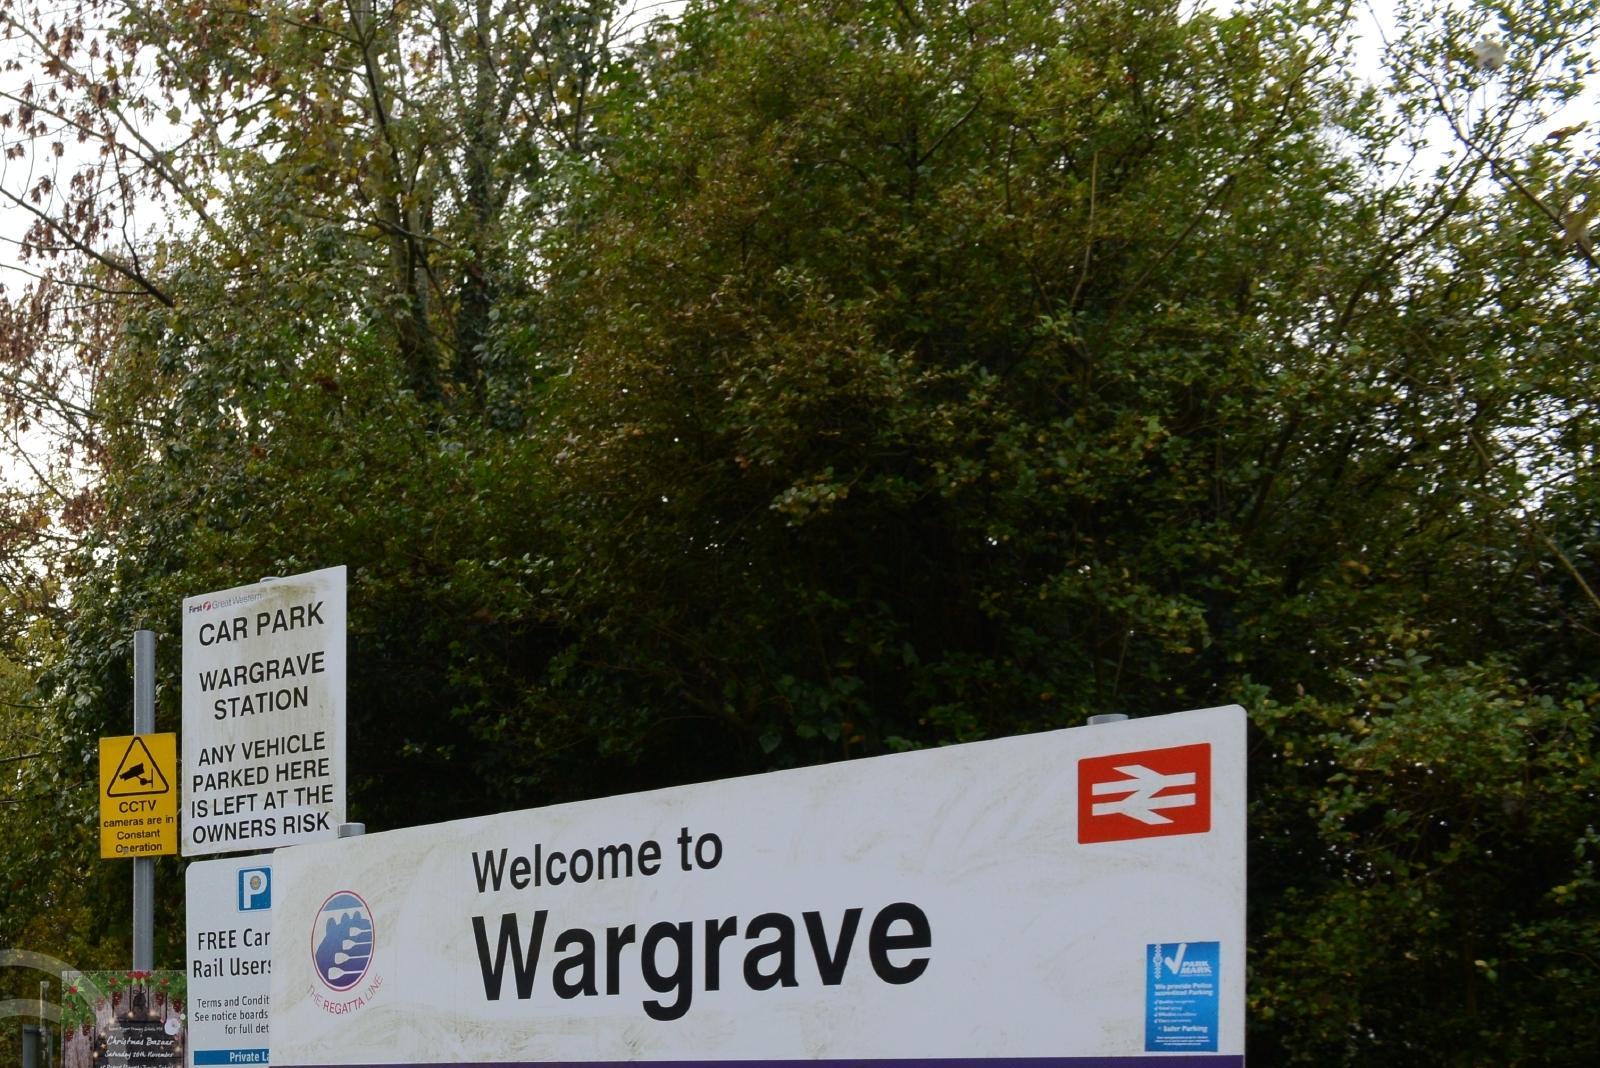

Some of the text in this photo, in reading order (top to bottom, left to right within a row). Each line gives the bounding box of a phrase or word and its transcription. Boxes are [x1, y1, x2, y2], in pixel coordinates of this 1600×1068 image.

[188, 604, 202, 614] First
[199, 601, 324, 646] CAR PARK
[200, 651, 325, 692] WARGRAVE
[214, 686, 308, 720] STATION
[199, 731, 326, 766] ANY VEHICLE
[193, 758, 329, 792] PARKED HERE
[118, 800, 156, 814] CCTV
[192, 784, 334, 818] IS LEFT AT THE
[104, 815, 174, 828] cameras are in
[192, 812, 330, 844] OWNERS RISK
[116, 828, 160, 840] Constant
[116, 842, 162, 854] Operation
[471, 826, 723, 894] Welcome to
[243, 870, 268, 909] P
[198, 928, 270, 950] FREE Car
[193, 958, 224, 978] Rail
[471, 902, 932, 1022] Wargrave
[197, 998, 222, 1008] Terms
[224, 996, 240, 1007] and
[307, 973, 384, 1014] THE REGATTA LINE
[194, 1009, 268, 1022] See notice boards
[225, 1024, 236, 1035] for
[239, 1024, 253, 1034] full
[106, 1035, 175, 1046] Christmas Bazaar
[105, 1050, 131, 1059] Saturday
[230, 1051, 260, 1062] Private
